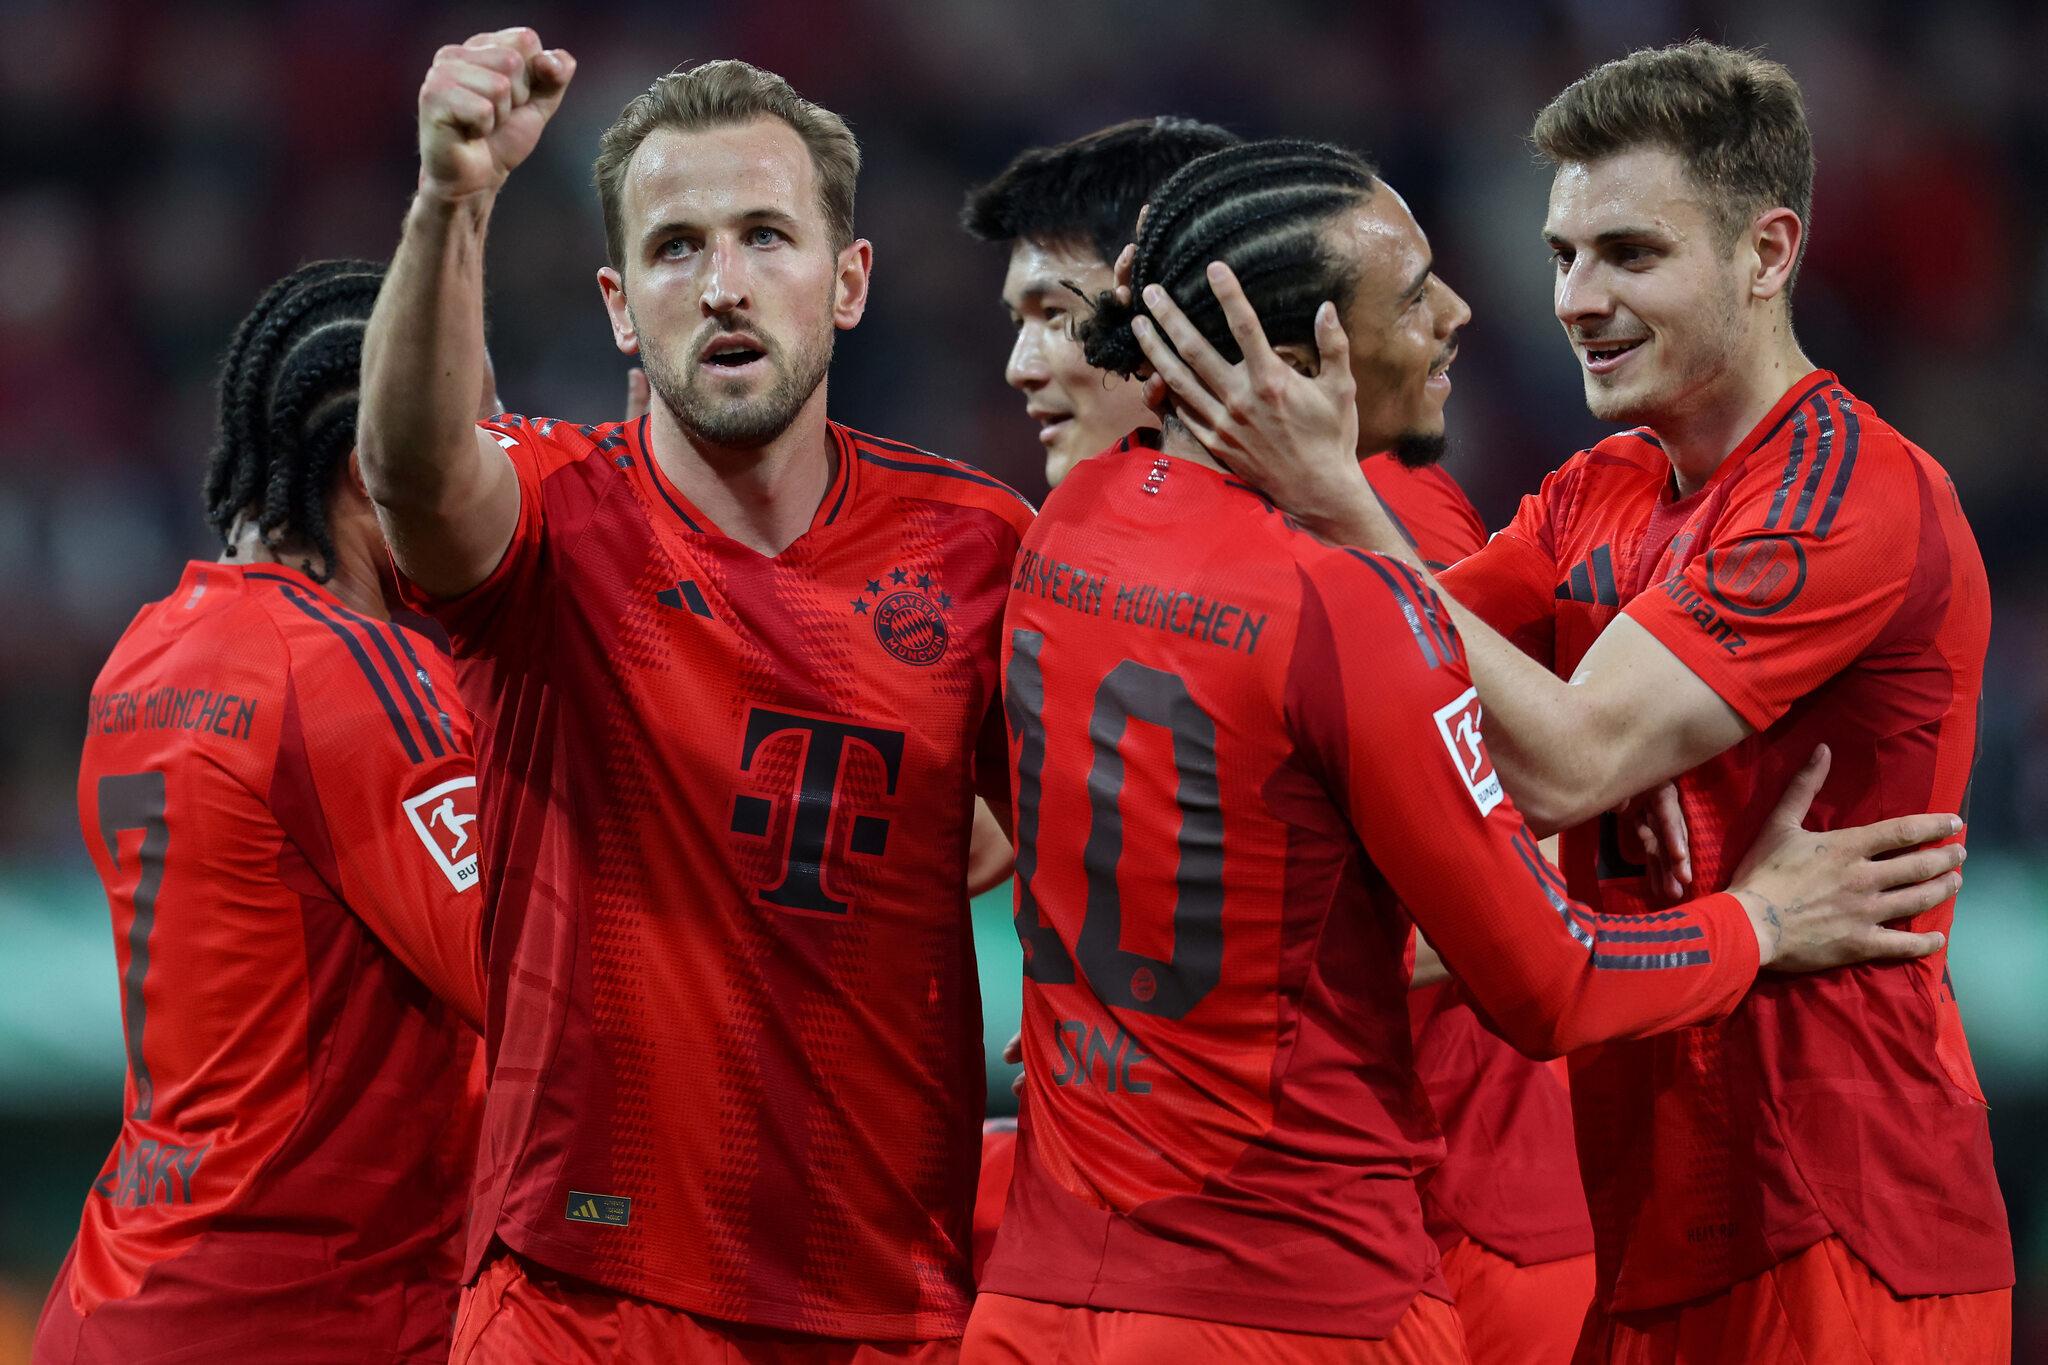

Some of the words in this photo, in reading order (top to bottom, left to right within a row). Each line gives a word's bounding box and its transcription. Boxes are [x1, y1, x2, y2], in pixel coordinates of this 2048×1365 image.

[880, 609, 892, 625] FC
[890, 597, 938, 622] BAYERN
[1112, 582, 1267, 655] MÜNCHEN
[1660, 573, 1747, 655] Allianz
[144, 687, 257, 740] MÜNCHEN
[740, 707, 906, 915] T
[1003, 628, 1224, 1021] 10
[457, 861, 478, 880] BU
[97, 771, 169, 1121] 7
